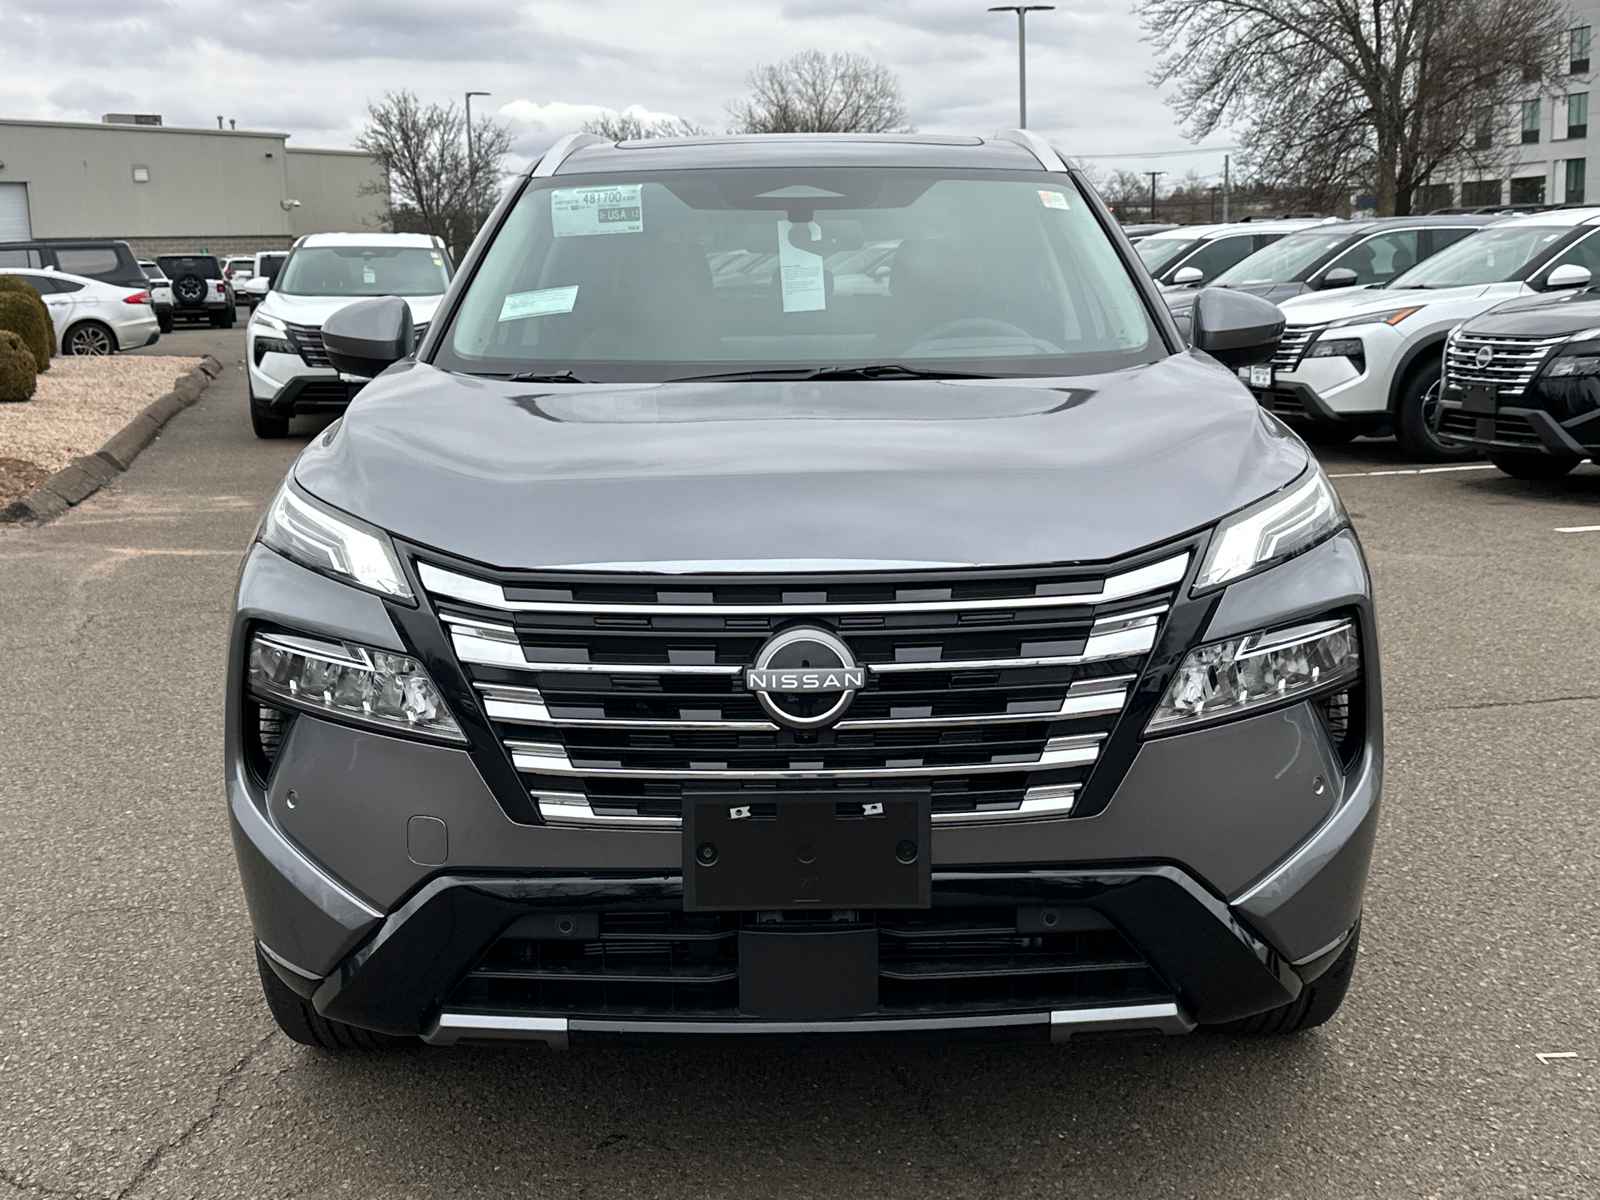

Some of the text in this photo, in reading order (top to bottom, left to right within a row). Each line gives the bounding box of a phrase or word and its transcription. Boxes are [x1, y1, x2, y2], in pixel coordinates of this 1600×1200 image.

[583, 191, 622, 204] 481700
[607, 209, 627, 220] USA
[749, 672, 862, 688] NISSAN
